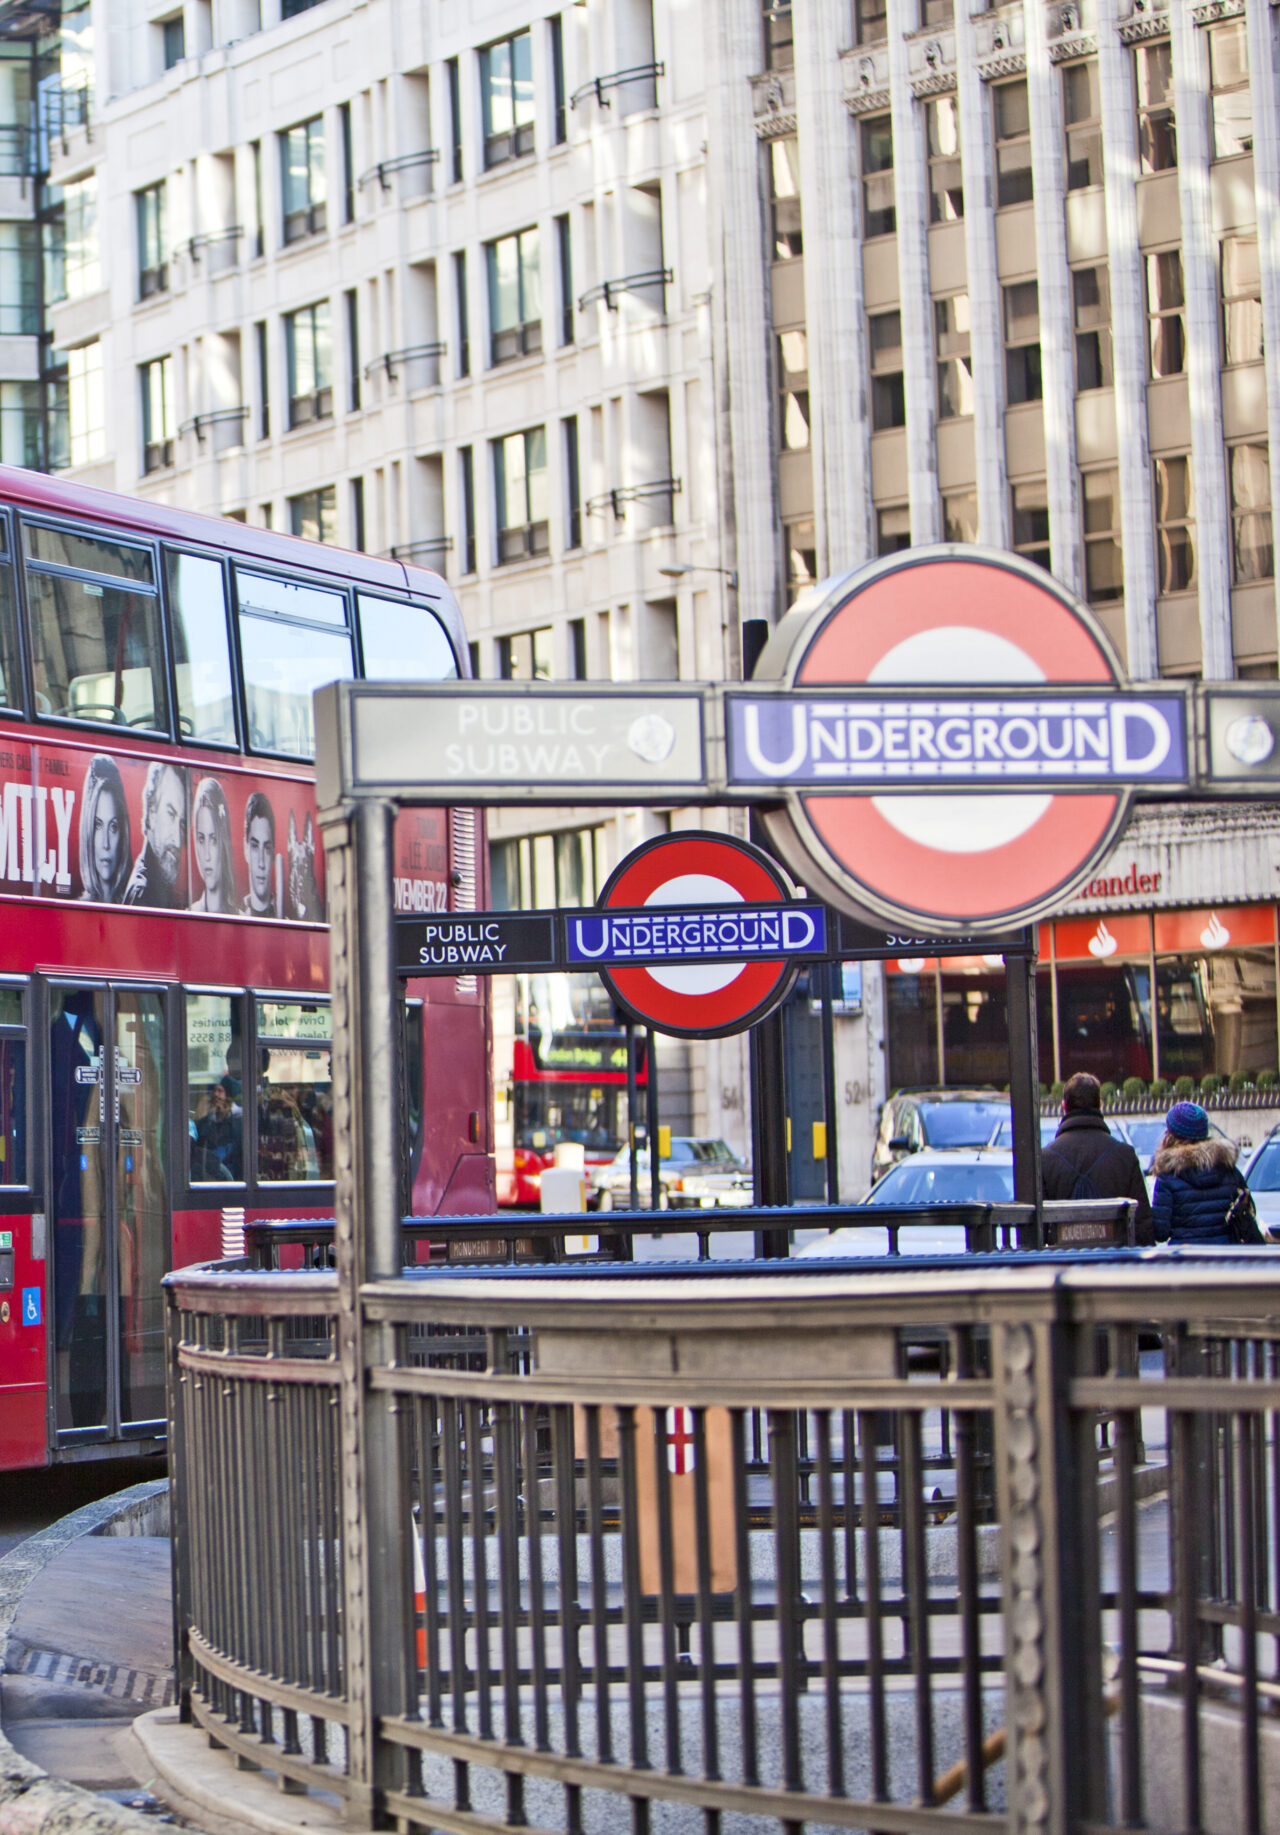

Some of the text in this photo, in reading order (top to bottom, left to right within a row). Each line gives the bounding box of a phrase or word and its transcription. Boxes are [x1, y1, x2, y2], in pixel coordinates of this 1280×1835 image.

[458, 703, 597, 736] PUBLIC
[744, 701, 1172, 777] UNDERGROUND
[445, 743, 612, 776] SUBWAY
[394, 877, 447, 913] VEMBER 22
[1076, 861, 1162, 899] tander
[426, 923, 501, 943] PUBLIC
[575, 911, 816, 958] UNDERGROUND
[419, 944, 507, 964] SUBWAY
[453, 1239, 526, 1256] MONUMENT STON
